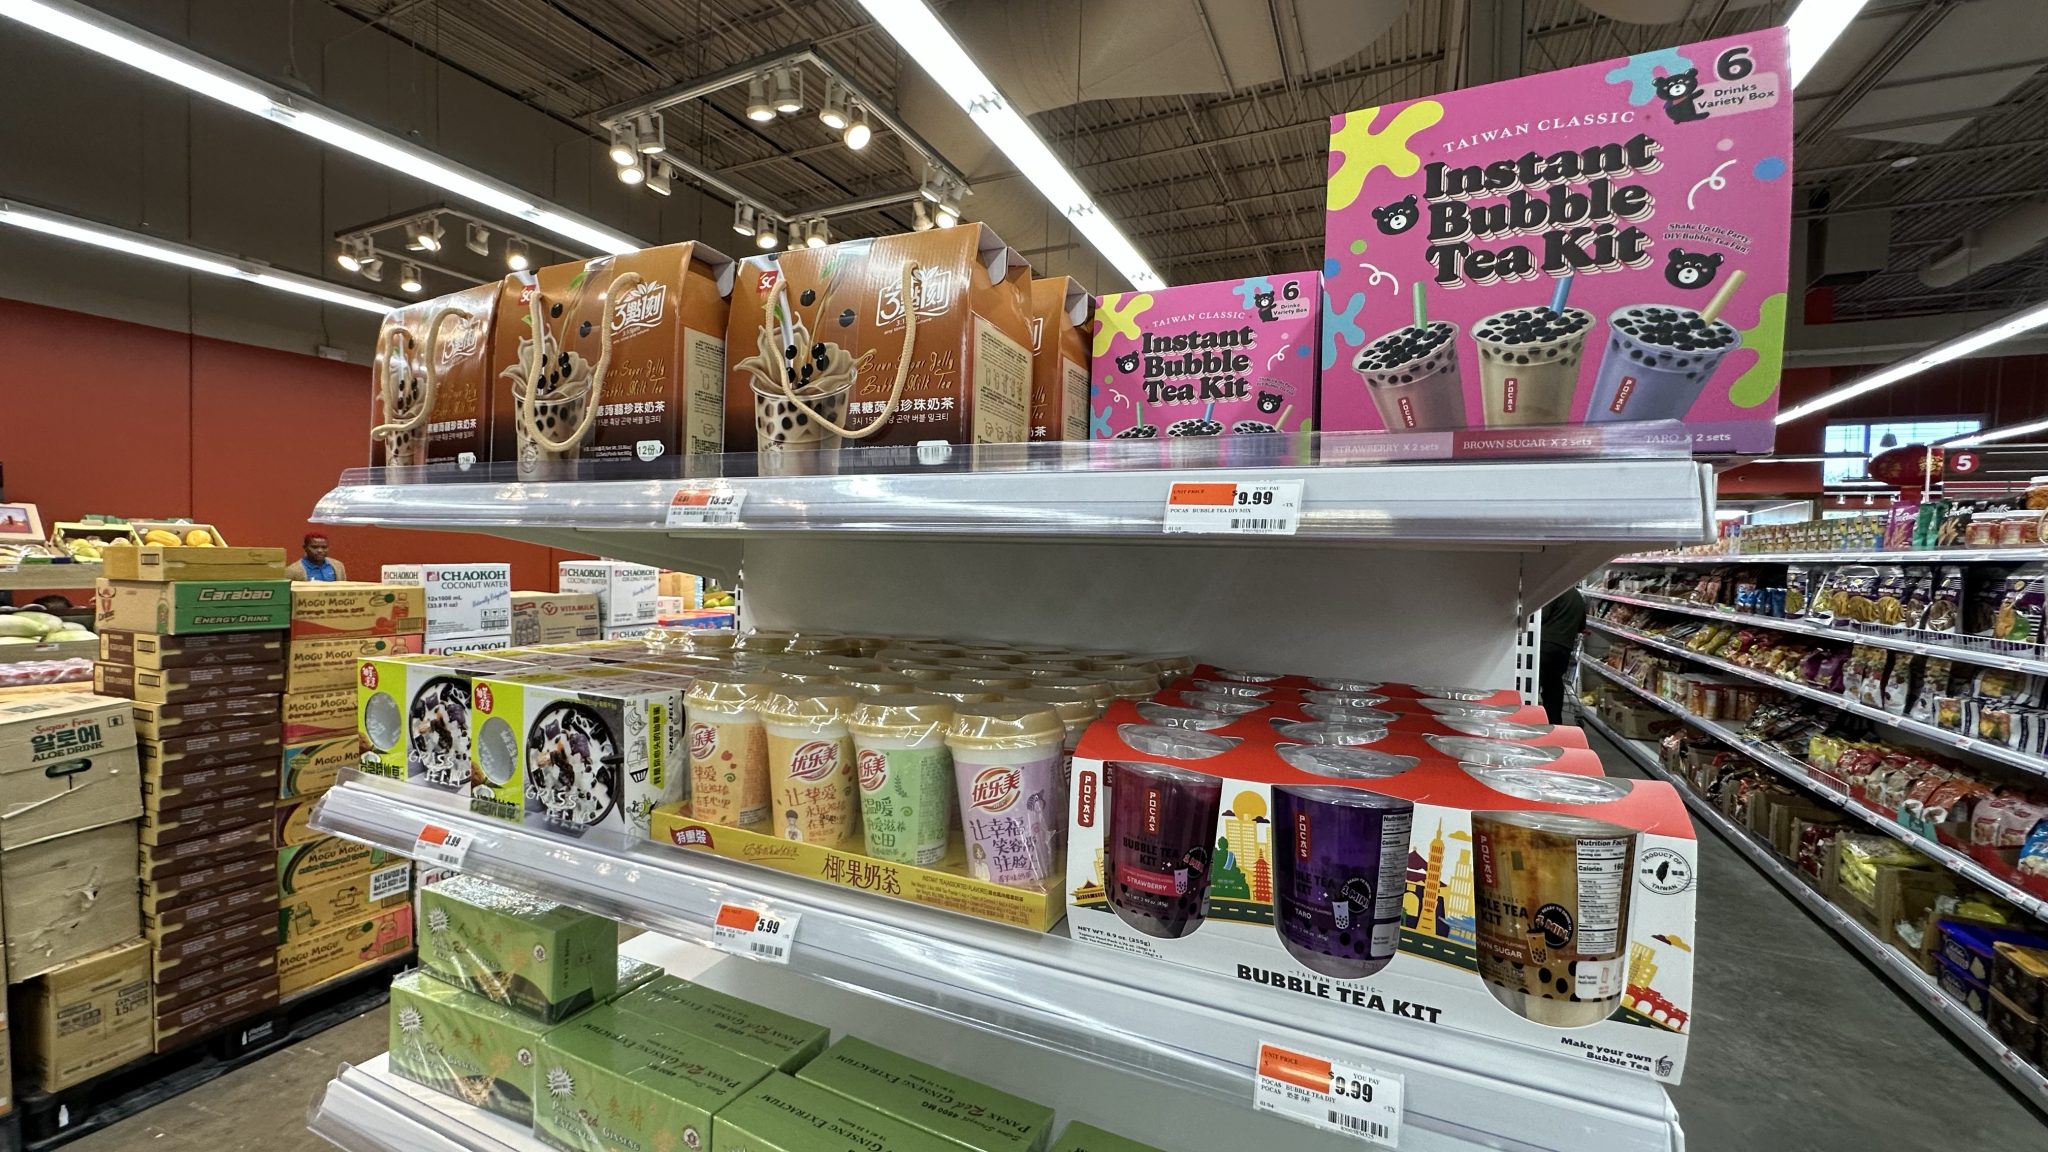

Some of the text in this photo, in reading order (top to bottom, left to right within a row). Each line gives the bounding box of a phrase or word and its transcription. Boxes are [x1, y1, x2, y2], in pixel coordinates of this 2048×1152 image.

[1716, 47, 1754, 81] 6
[1698, 88, 1775, 111] Variety Box
[1714, 82, 1757, 98] Drinks
[1443, 110, 1635, 154] TAIWAN CLASSIC
[1424, 133, 1664, 202] Instant
[1428, 176, 1655, 245] Bubble
[1425, 222, 1655, 289] Tea Kit
[1282, 281, 1300, 300] 6
[1152, 311, 1246, 328] TAIWAN CLASSIC
[1142, 325, 1257, 356] Instant
[1143, 348, 1252, 381] Bubble
[1143, 380, 1197, 407] Tea
[1200, 373, 1252, 404] Kit
[1507, 380, 1515, 412] POCAS
[1412, 443, 1418, 452] 2
[1420, 441, 1440, 452] sets
[1463, 437, 1592, 451] BROWN SUGAR X 2 sets
[1645, 431, 1731, 445] TARO 2 sets
[1956, 455, 1974, 471] 5
[441, 570, 507, 581] CHAOKOH
[568, 569, 606, 577] CHAOKOH
[622, 568, 656, 577] CHAOKOH
[199, 588, 274, 602] Carabao
[441, 582, 481, 590] COCONUT
[297, 597, 356, 608] MOGU MOGU
[560, 604, 595, 613] VITAMILK
[193, 614, 271, 625] ENERGY DRINK
[294, 651, 352, 662] MOGU MOGU
[288, 699, 347, 712] MOGU MOGU
[35, 718, 94, 735] Sugar Free
[31, 724, 102, 754] 알로에
[32, 741, 105, 763] ALOE DRINK
[790, 742, 839, 773] 优乐美
[971, 769, 1021, 803] 优乐美
[1083, 775, 1092, 823] POCAS
[1148, 791, 1156, 832] POCAS
[969, 816, 1026, 841] 让幸福
[1299, 815, 1308, 858] POCAS
[871, 833, 896, 848] 心田
[1123, 837, 1158, 856] BUBBLE
[1577, 839, 1611, 847] Nutrition
[308, 852, 336, 863] MOGU
[1139, 855, 1157, 866] KIT
[1480, 835, 1493, 884] POCAS
[1641, 852, 1683, 865] PRODUCT OF
[821, 853, 901, 895] 椰果奶茶
[1127, 876, 1168, 891] STRAWBERRY
[1651, 882, 1678, 891] TAIWAN
[1295, 908, 1312, 919] TARO
[1502, 903, 1529, 920] TEA
[1077, 925, 1091, 933] NET
[279, 941, 338, 967] MOGU MOGU
[1493, 944, 1523, 959] SUGAR
[1296, 971, 1377, 993] TAIWAN CLASSIC
[1237, 963, 1442, 1024] BUBBLE TEA KIT
[1264, 1051, 1298, 1065] UNIT PRICE
[1561, 1037, 1652, 1063] Make your own
[1586, 1051, 1651, 1072] Bubble Tea
[706, 1070, 741, 1089] PANAX
[1328, 1071, 1373, 1102] $9.99
[1353, 1073, 1380, 1086] YOU PAY
[835, 1054, 1032, 1133] PANAX Red GINSENG EXTRACTUM
[1261, 1085, 1281, 1095] POCAS
[1261, 1078, 1336, 1103] POCAS BUBBLE TEA DIY
[921, 1100, 936, 1111] MG
[759, 1093, 883, 1149] GINSENG EXTRACTUM
[602, 1126, 641, 1152] GINSENG
